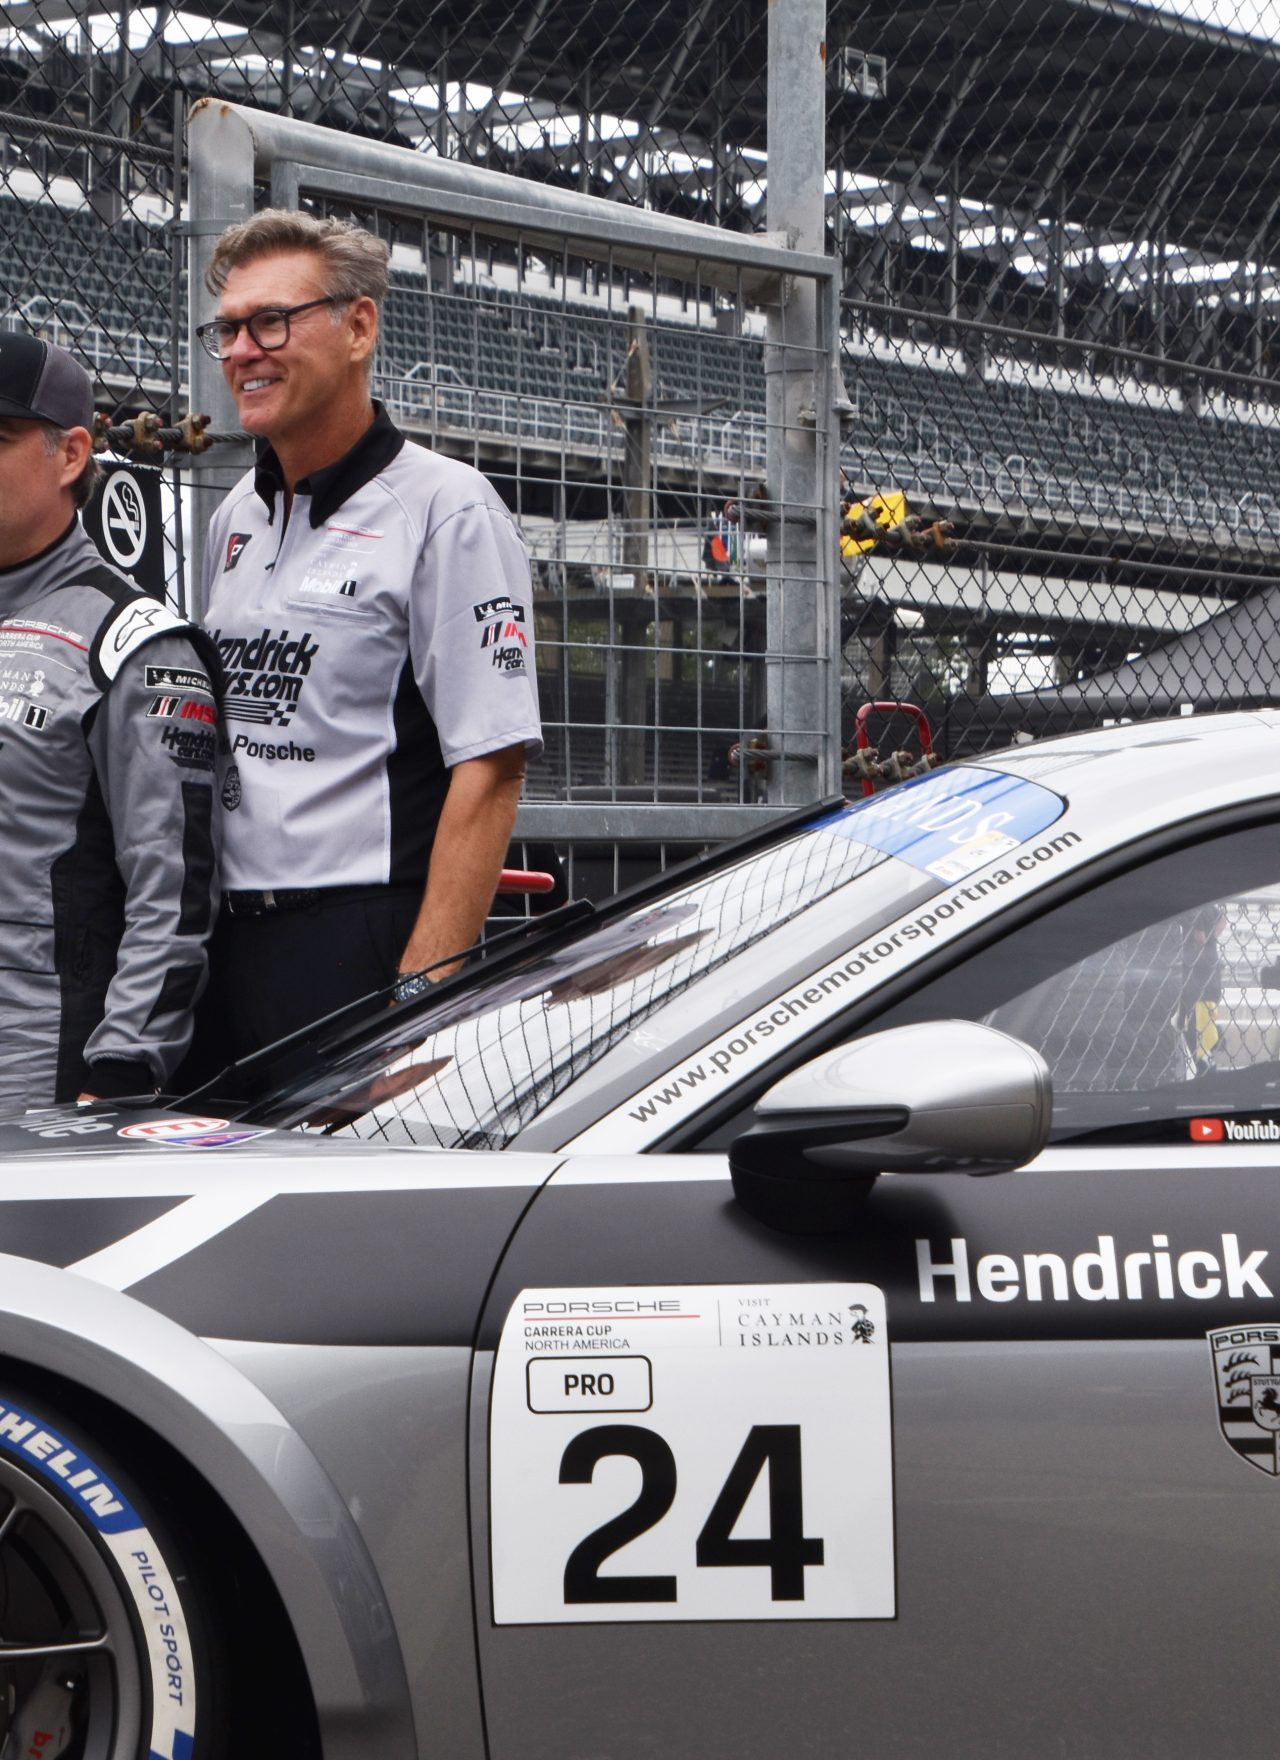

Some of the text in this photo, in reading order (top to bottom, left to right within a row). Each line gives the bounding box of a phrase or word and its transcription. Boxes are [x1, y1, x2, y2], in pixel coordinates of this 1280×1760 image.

[299, 576, 341, 594] Mobil
[1, 619, 84, 641] PORSCHE
[210, 629, 320, 676] endrick
[223, 671, 304, 702] rs.com
[180, 699, 217, 725] IMS
[233, 734, 315, 762] Porsche
[628, 828, 1083, 1123] www.porschemotorsportna.com
[915, 1233, 1274, 1303] Hendrick
[523, 1300, 680, 1314] PORSCHE
[738, 1298, 772, 1307] VISIT
[524, 1325, 612, 1337] CARRERA CUP
[738, 1312, 842, 1327] CAYMAN
[525, 1338, 631, 1351] NORTH AMERICA
[739, 1331, 844, 1347] ISLANDS
[563, 1373, 615, 1396] PRO
[558, 1424, 824, 1604] 24
[131, 1551, 183, 1707] PILOT SPORT
